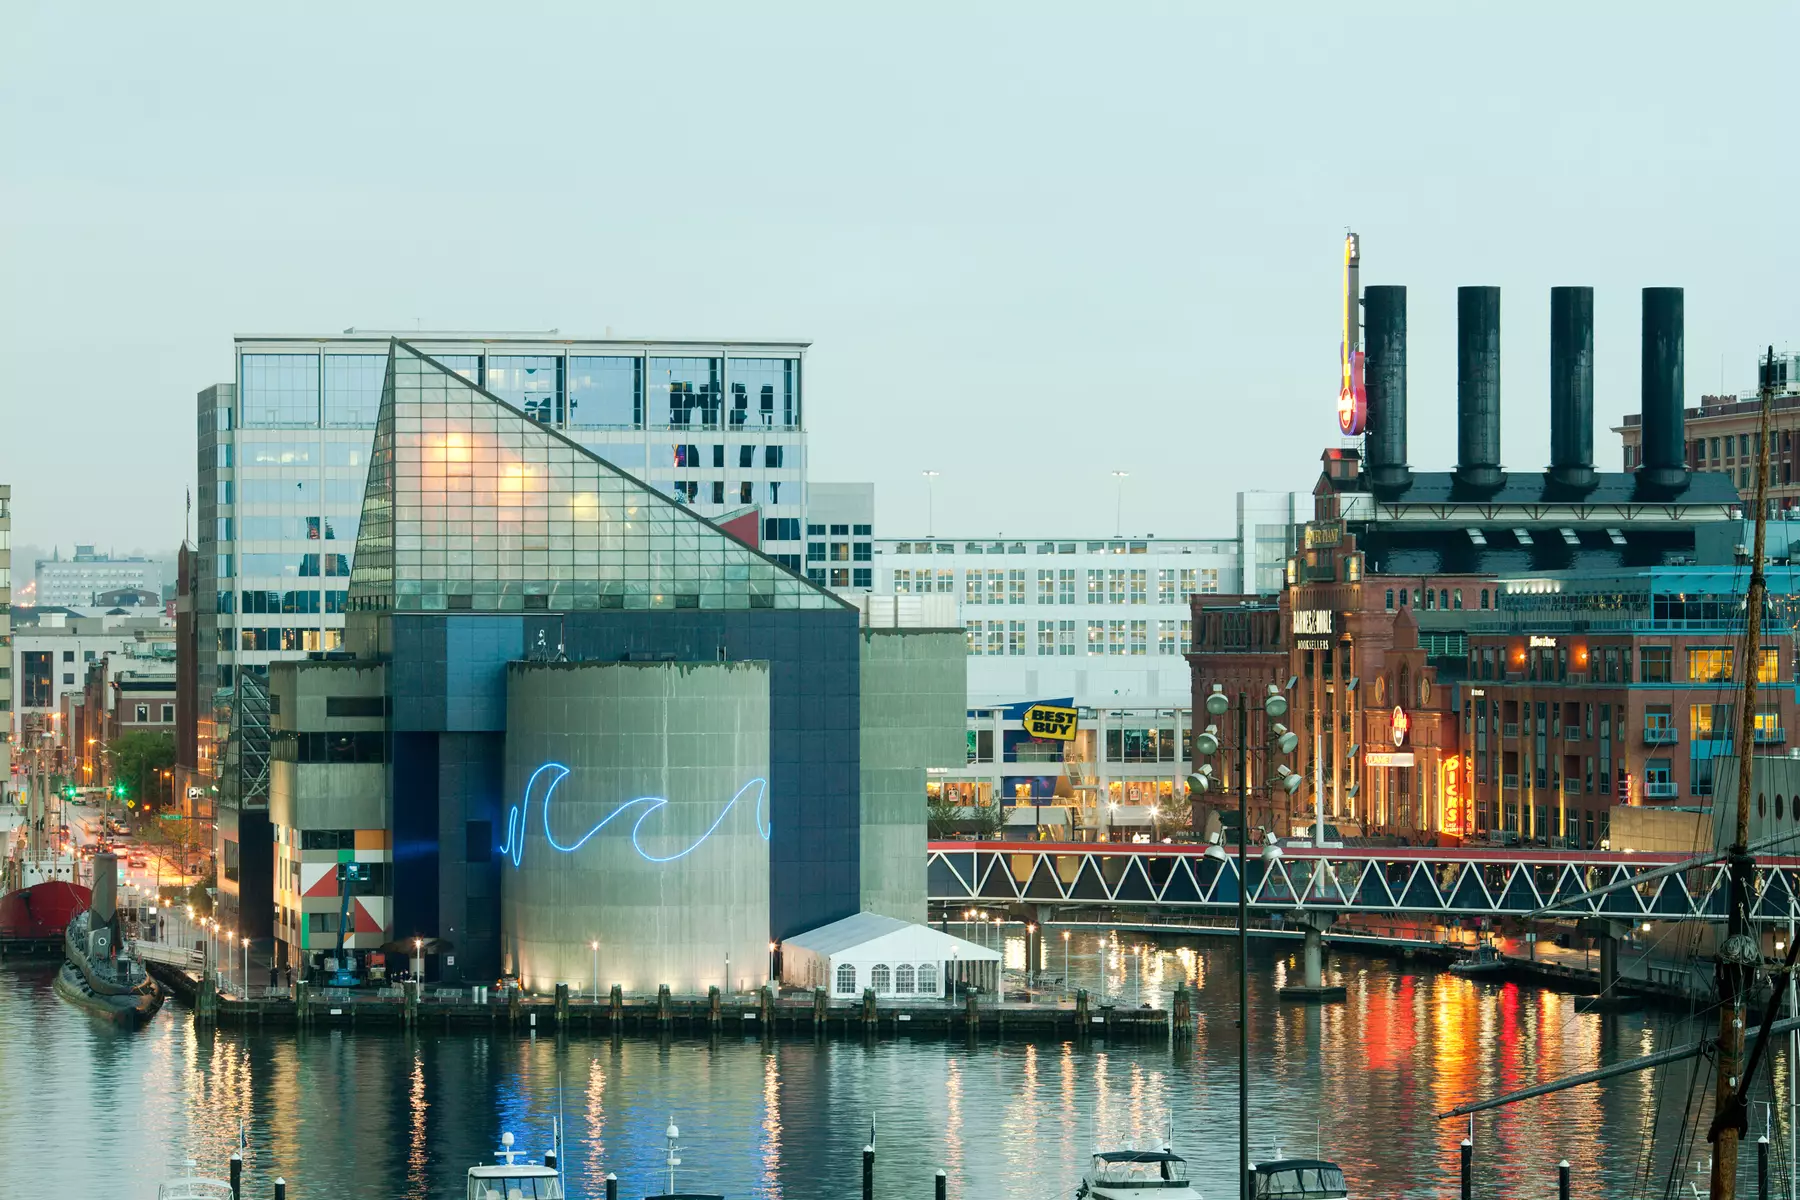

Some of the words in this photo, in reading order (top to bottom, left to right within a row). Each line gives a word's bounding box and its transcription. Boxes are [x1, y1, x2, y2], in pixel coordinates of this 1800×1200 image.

[1297, 639, 1329, 650] BOOKSELLERS
[1032, 709, 1077, 724] BEST
[1032, 721, 1071, 735] BUY
